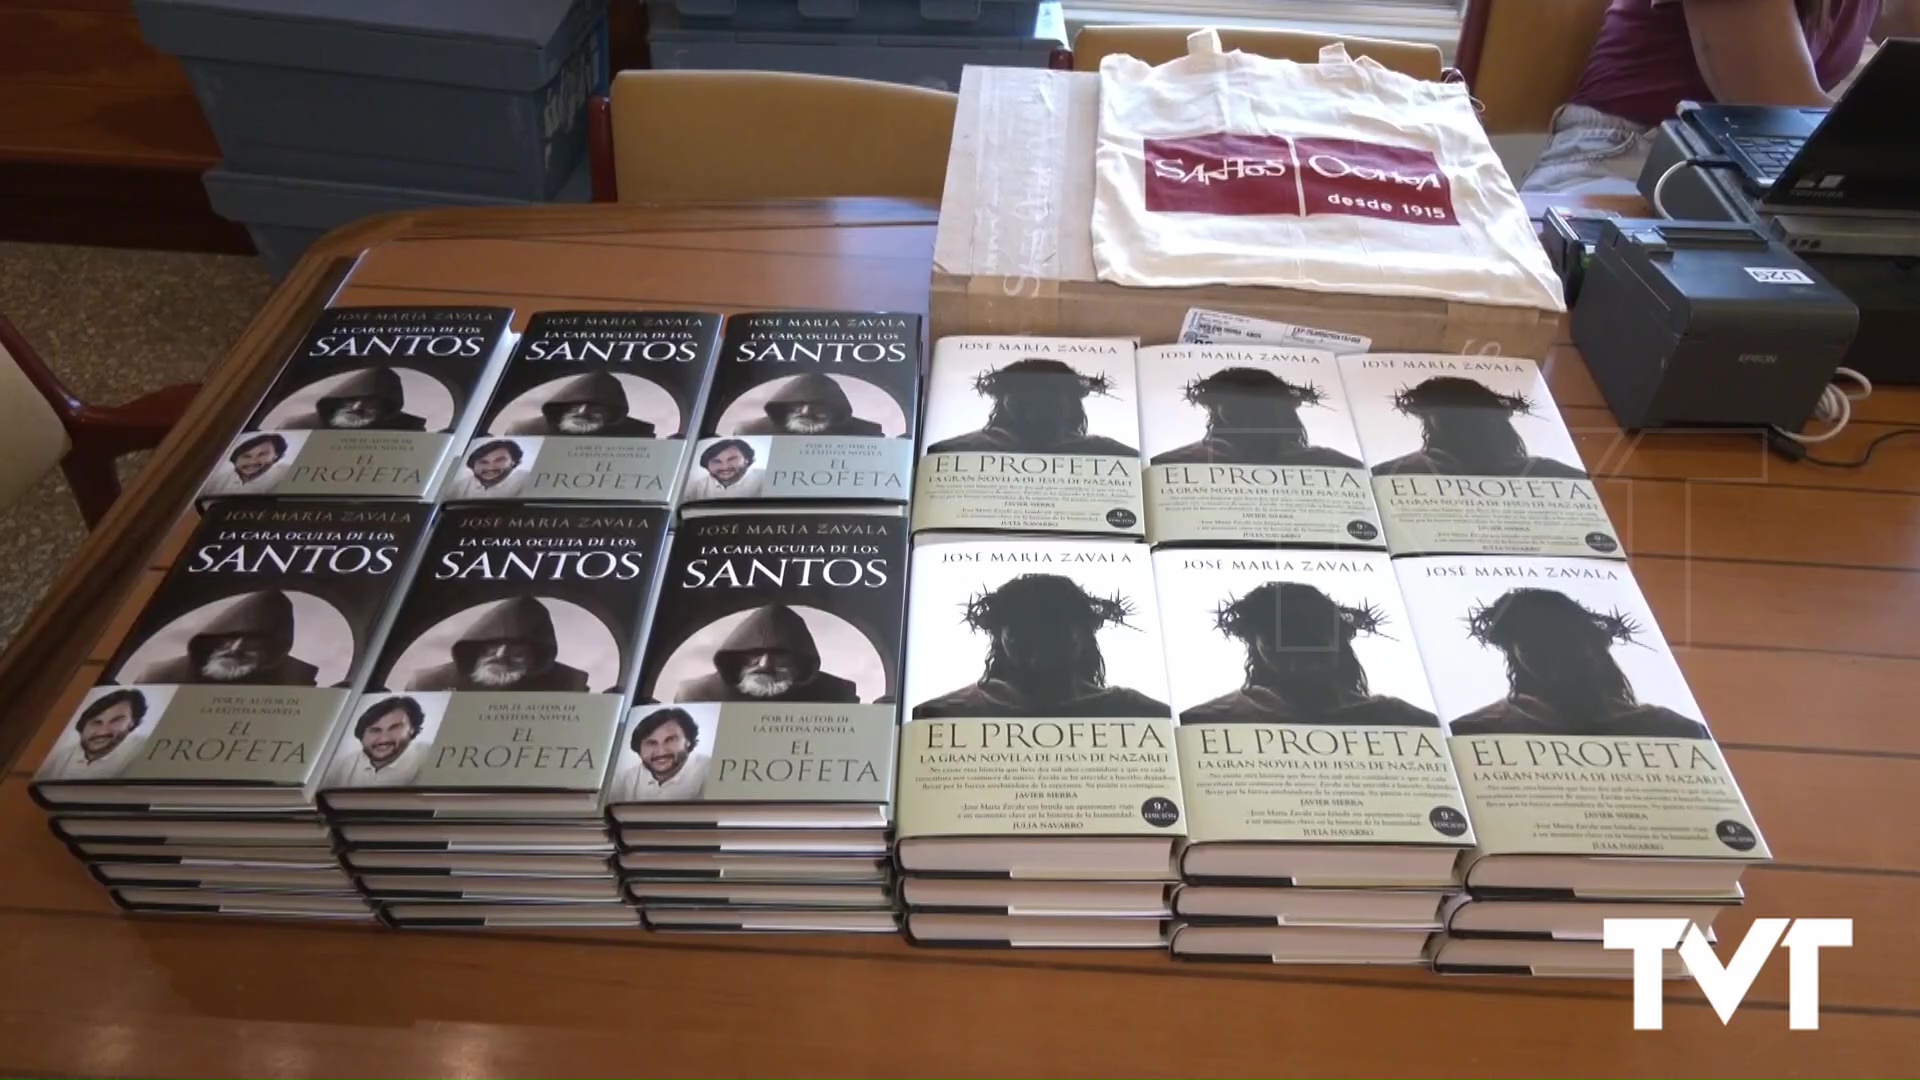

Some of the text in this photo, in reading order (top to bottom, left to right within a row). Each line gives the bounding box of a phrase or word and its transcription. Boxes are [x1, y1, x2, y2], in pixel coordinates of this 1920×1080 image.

[1328, 194, 1446, 219] desde 1915
[434, 313, 493, 321] ZAVALA
[644, 318, 703, 327] ZAVALA
[847, 319, 906, 328] ZAVALA
[600, 331, 648, 339] OCULTA
[309, 335, 485, 357] SANTOS
[525, 341, 698, 362] SANTOS
[736, 341, 907, 363] SANTOS
[1057, 344, 1117, 354] ZAVALA
[1260, 353, 1321, 364] ZAVALA
[1464, 362, 1524, 373] ZAVALA
[356, 455, 374, 465] EL
[831, 459, 849, 470] EL
[936, 455, 1130, 478] EL PROFETA
[595, 462, 613, 472] EL
[292, 466, 421, 484] PROFETA
[534, 473, 663, 490] PROFETA
[772, 470, 902, 488] PROFETA
[1164, 467, 1361, 489] EL PROFETA
[1391, 478, 1593, 500] EL PROFETA
[340, 512, 412, 523] ZAVALA
[577, 518, 649, 529] ZAVALA
[219, 531, 396, 541] LA CARA OCULTA DE LOS
[817, 524, 888, 535] ZAVALA
[459, 537, 637, 547] LA CARA OCULTA DE LOS
[701, 544, 879, 555] LA CARA OCULTA DE LOS
[188, 544, 399, 574] SANTOS
[1061, 553, 1132, 563] ZAVALA
[435, 550, 643, 580] SANTOS
[1301, 560, 1375, 573] ZAVALA
[682, 557, 888, 588] SANTOS
[1546, 567, 1618, 581] ZAVALA
[799, 715, 834, 723] AUTOR
[228, 721, 250, 736] EL
[512, 727, 534, 742] EL
[811, 726, 855, 734] NOVELA
[927, 723, 1166, 749] EL PROFETA
[791, 740, 814, 755] EL
[1200, 729, 1442, 758] EL PROFETA
[147, 738, 306, 764] PROFETA
[435, 745, 594, 769] PROFETA
[1470, 740, 1717, 771] EL PROFETA
[920, 753, 936, 764] LA
[938, 753, 976, 764] GRAN
[981, 753, 1032, 764] NOVELA
[1035, 753, 1050, 764] DE
[1090, 753, 1106, 764] DE
[1109, 753, 1169, 764] NAZARET
[718, 759, 880, 782] PROFETA
[1198, 760, 1214, 769] LA
[1216, 760, 1255, 769] GRAN
[1258, 760, 1310, 770] NOVELA
[1313, 760, 1328, 770] DE
[1368, 761, 1384, 771] DE
[1388, 761, 1448, 772] NAZARET
[1474, 772, 1490, 781] LA
[1493, 772, 1532, 781] GRAN
[1535, 772, 1587, 782] NOVELA
[1591, 773, 1606, 782] DE
[1646, 774, 1662, 783] DE
[1668, 774, 1726, 785] NAZARET
[1015, 792, 1043, 800] JAVIER
[1040, 821, 1083, 829] NAVARRO
